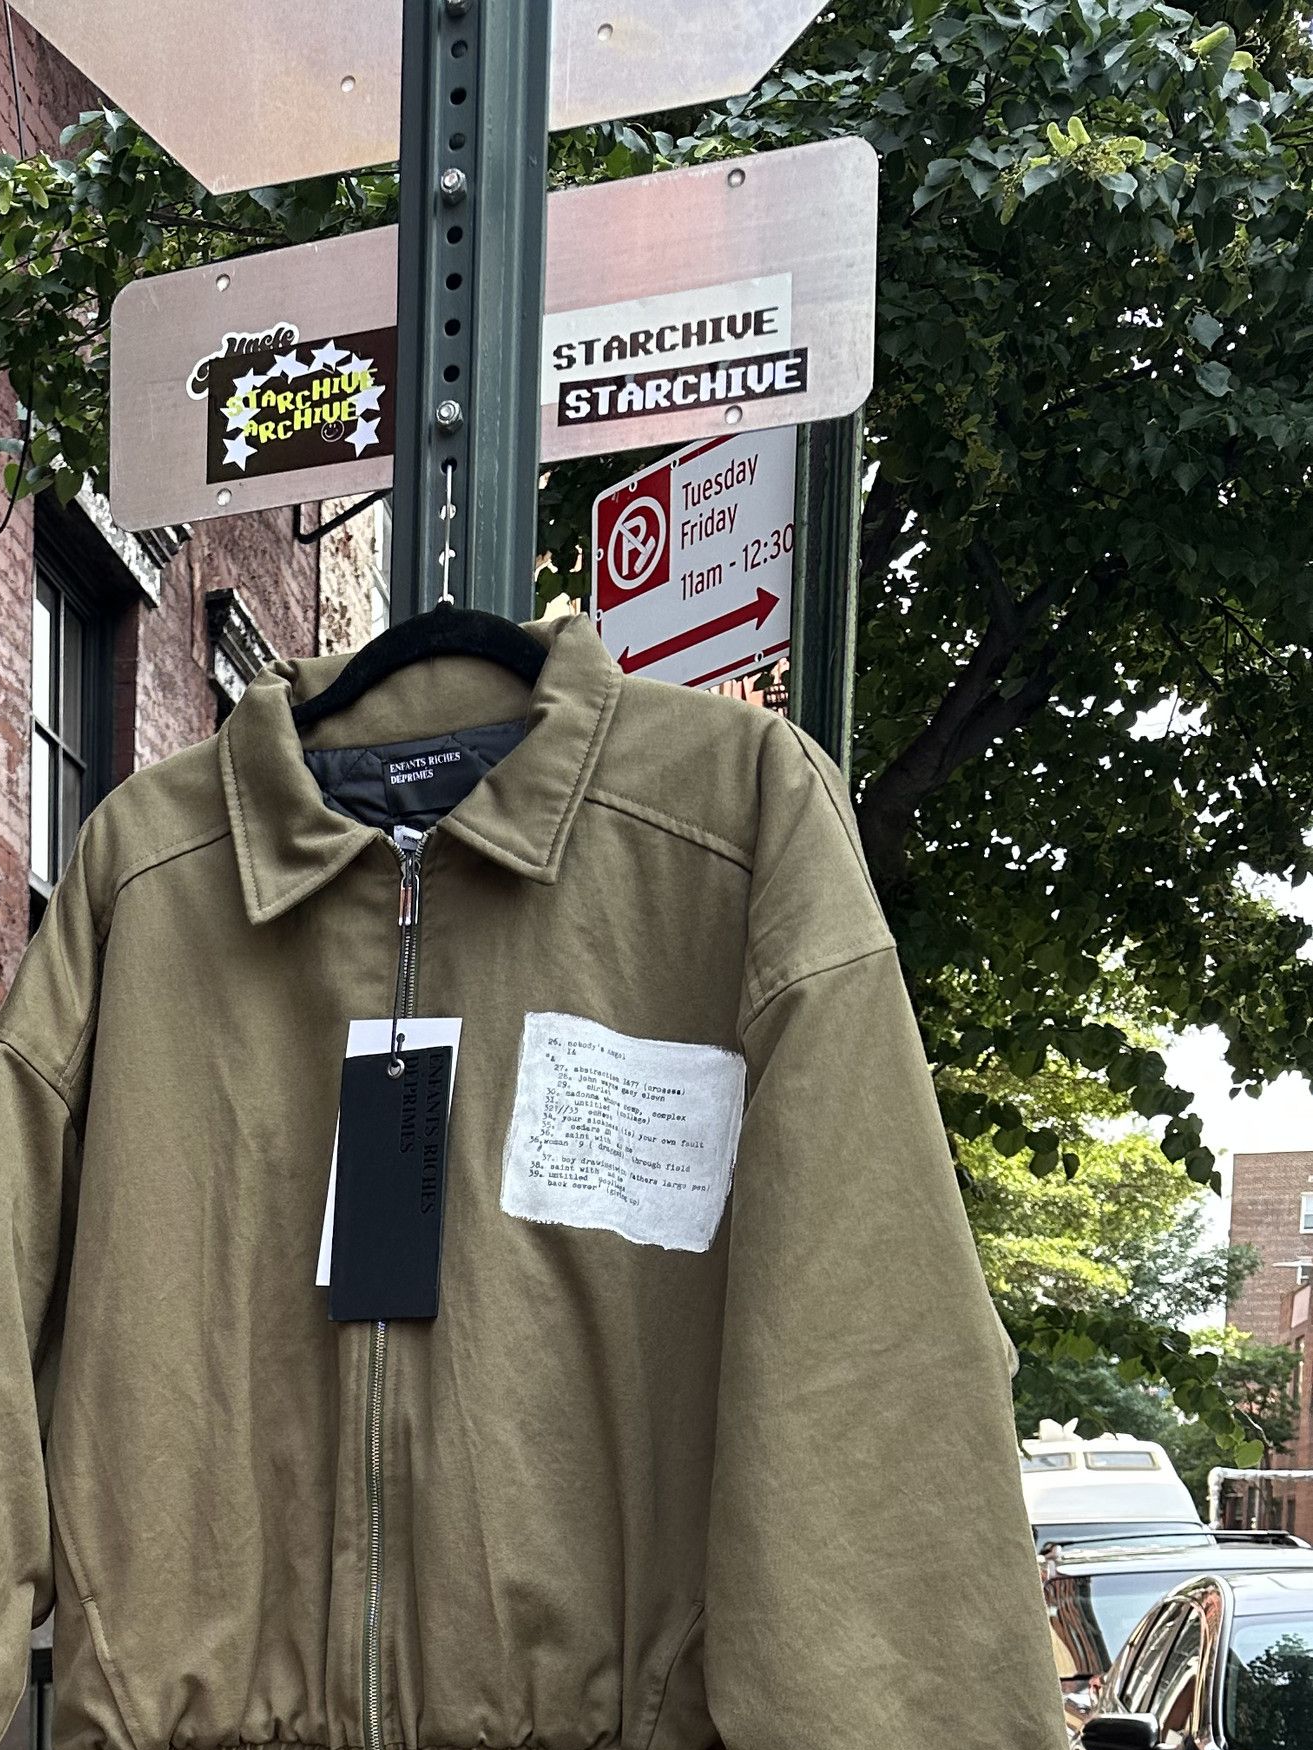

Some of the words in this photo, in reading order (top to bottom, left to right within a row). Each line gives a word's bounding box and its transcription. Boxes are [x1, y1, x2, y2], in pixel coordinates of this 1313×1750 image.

[225, 327, 295, 357] Uncle
[553, 306, 779, 370] STARCHIVE
[225, 368, 378, 417] STARCHIVE
[565, 358, 802, 419] STARCHIVE
[243, 399, 359, 444] ARCHIVE
[682, 454, 759, 511] Tuesday
[681, 504, 738, 550] Friday
[681, 563, 722, 601] 11am
[742, 523, 795, 573] 12:30
[390, 758, 427, 773] ENFANTS
[428, 751, 461, 765] RICHES
[421, 1143, 439, 1215] RICHES
